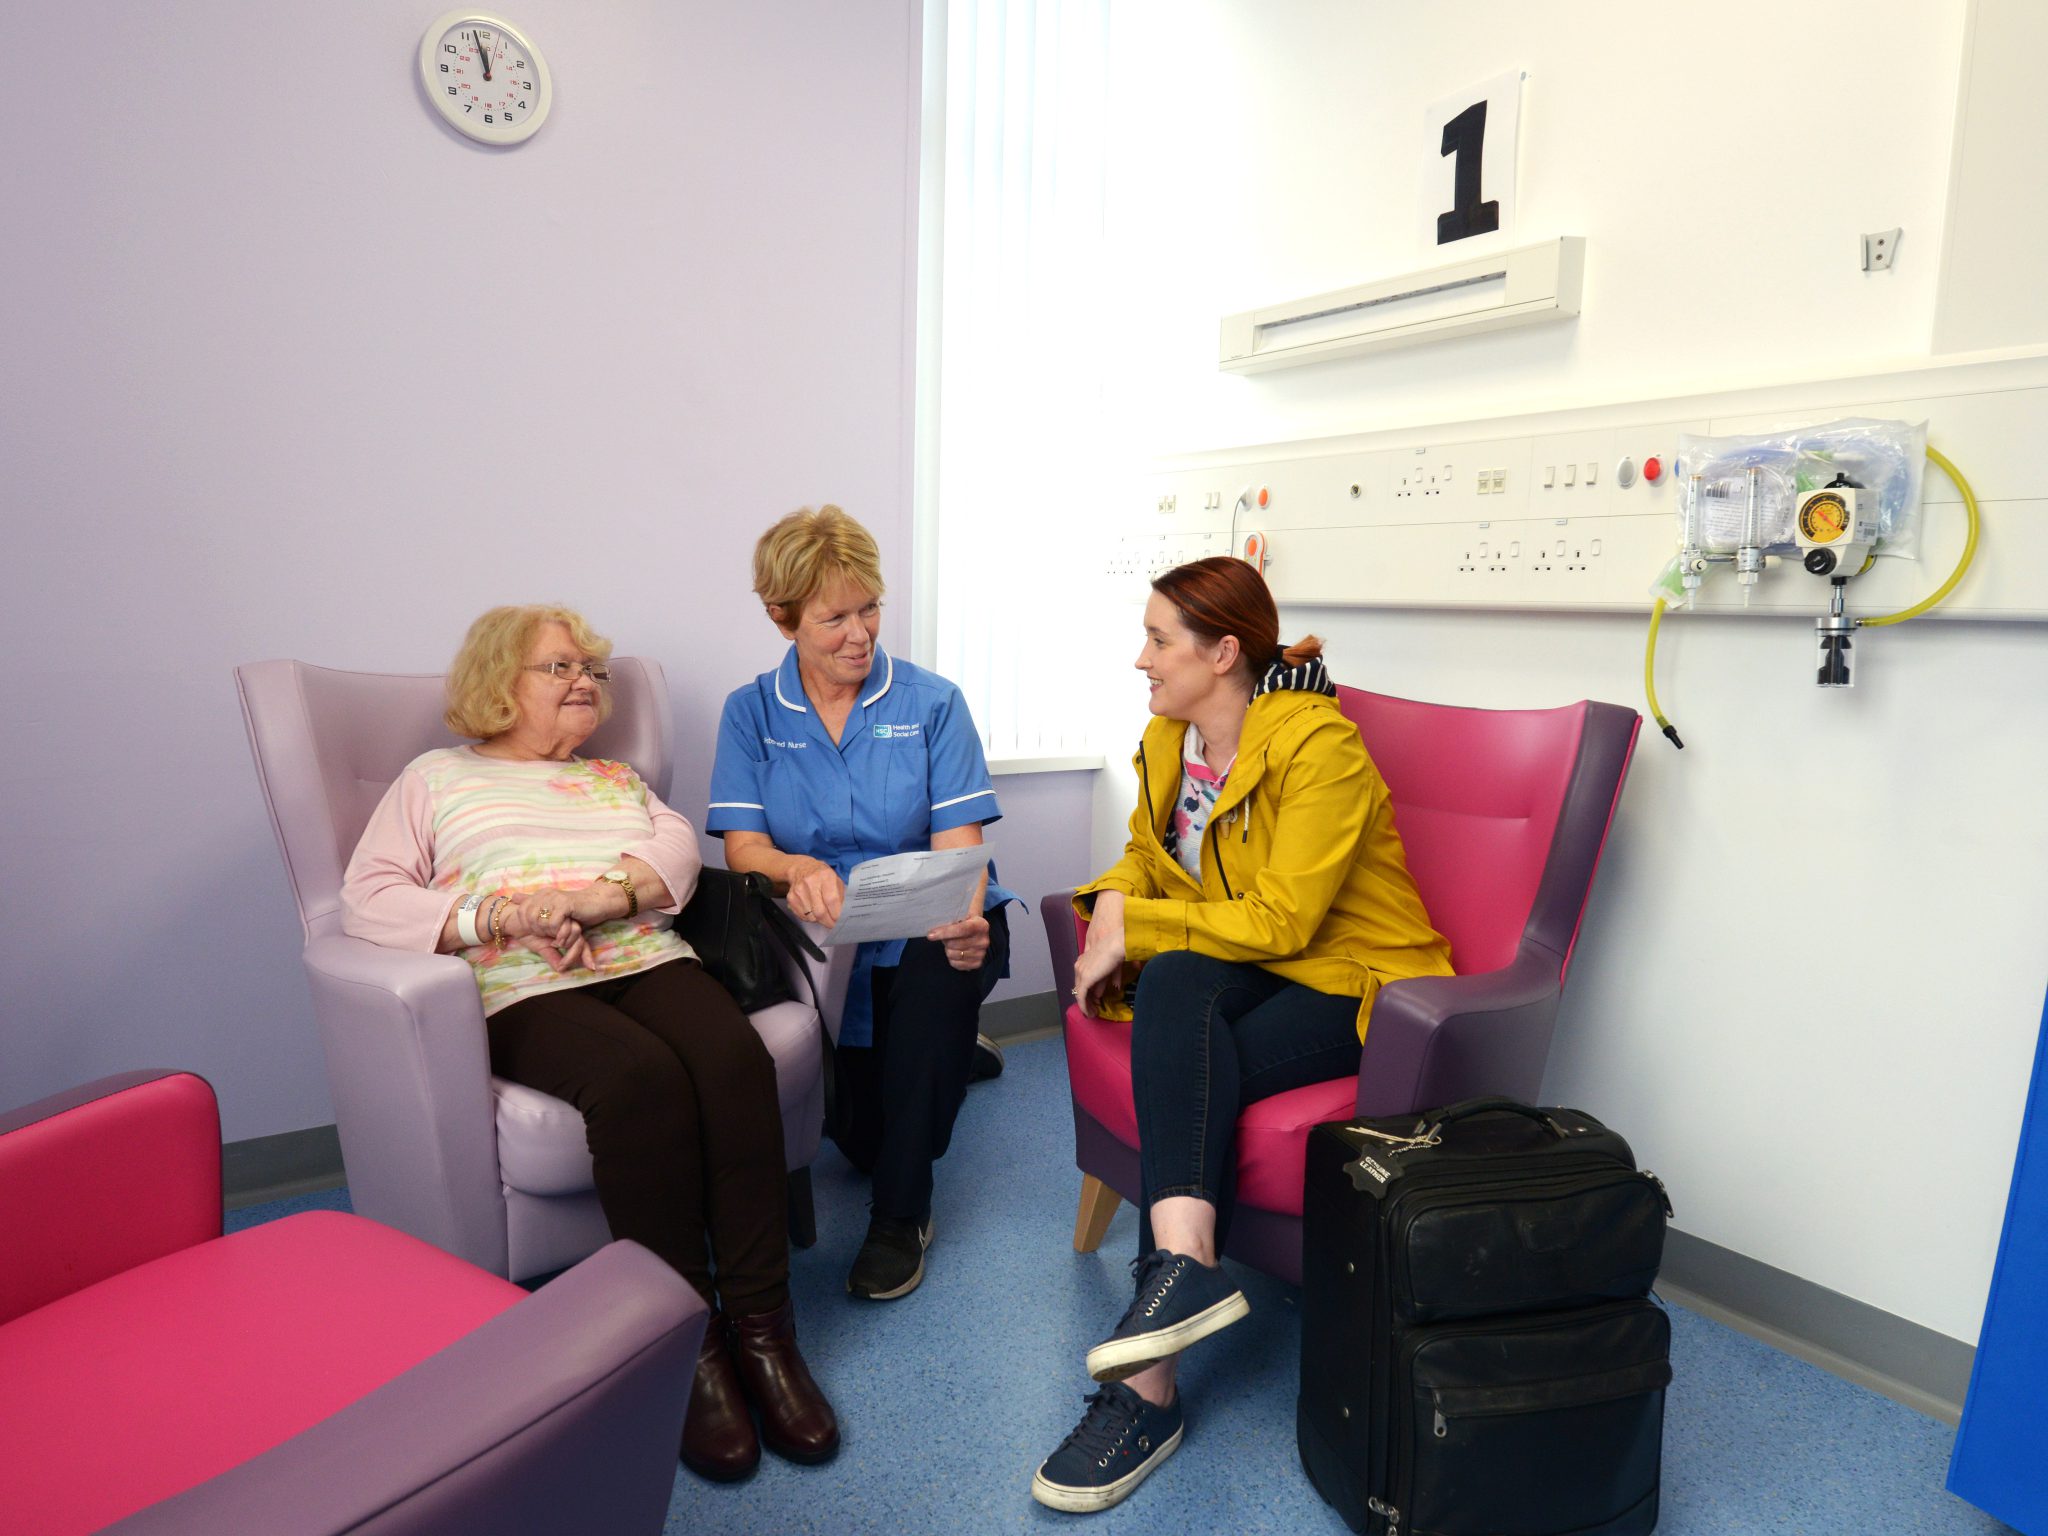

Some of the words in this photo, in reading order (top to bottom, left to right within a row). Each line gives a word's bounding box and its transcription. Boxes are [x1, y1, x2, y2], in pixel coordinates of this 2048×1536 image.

[462, 32, 469, 40] 11
[479, 30, 490, 40] 12
[445, 44, 456, 53] 10
[440, 63, 449, 73] 9
[516, 60, 525, 69] 2
[523, 81, 532, 90] 3
[448, 86, 457, 95] 8
[464, 104, 472, 112] 7
[518, 101, 526, 109] 4
[484, 114, 493, 124] 6
[504, 112, 513, 121] 5
[1437, 99, 1499, 245] 1
[788, 741, 807, 749] Nurse
[1359, 1160, 1386, 1184] LEATHER
[1365, 1156, 1391, 1179] GENUINE
